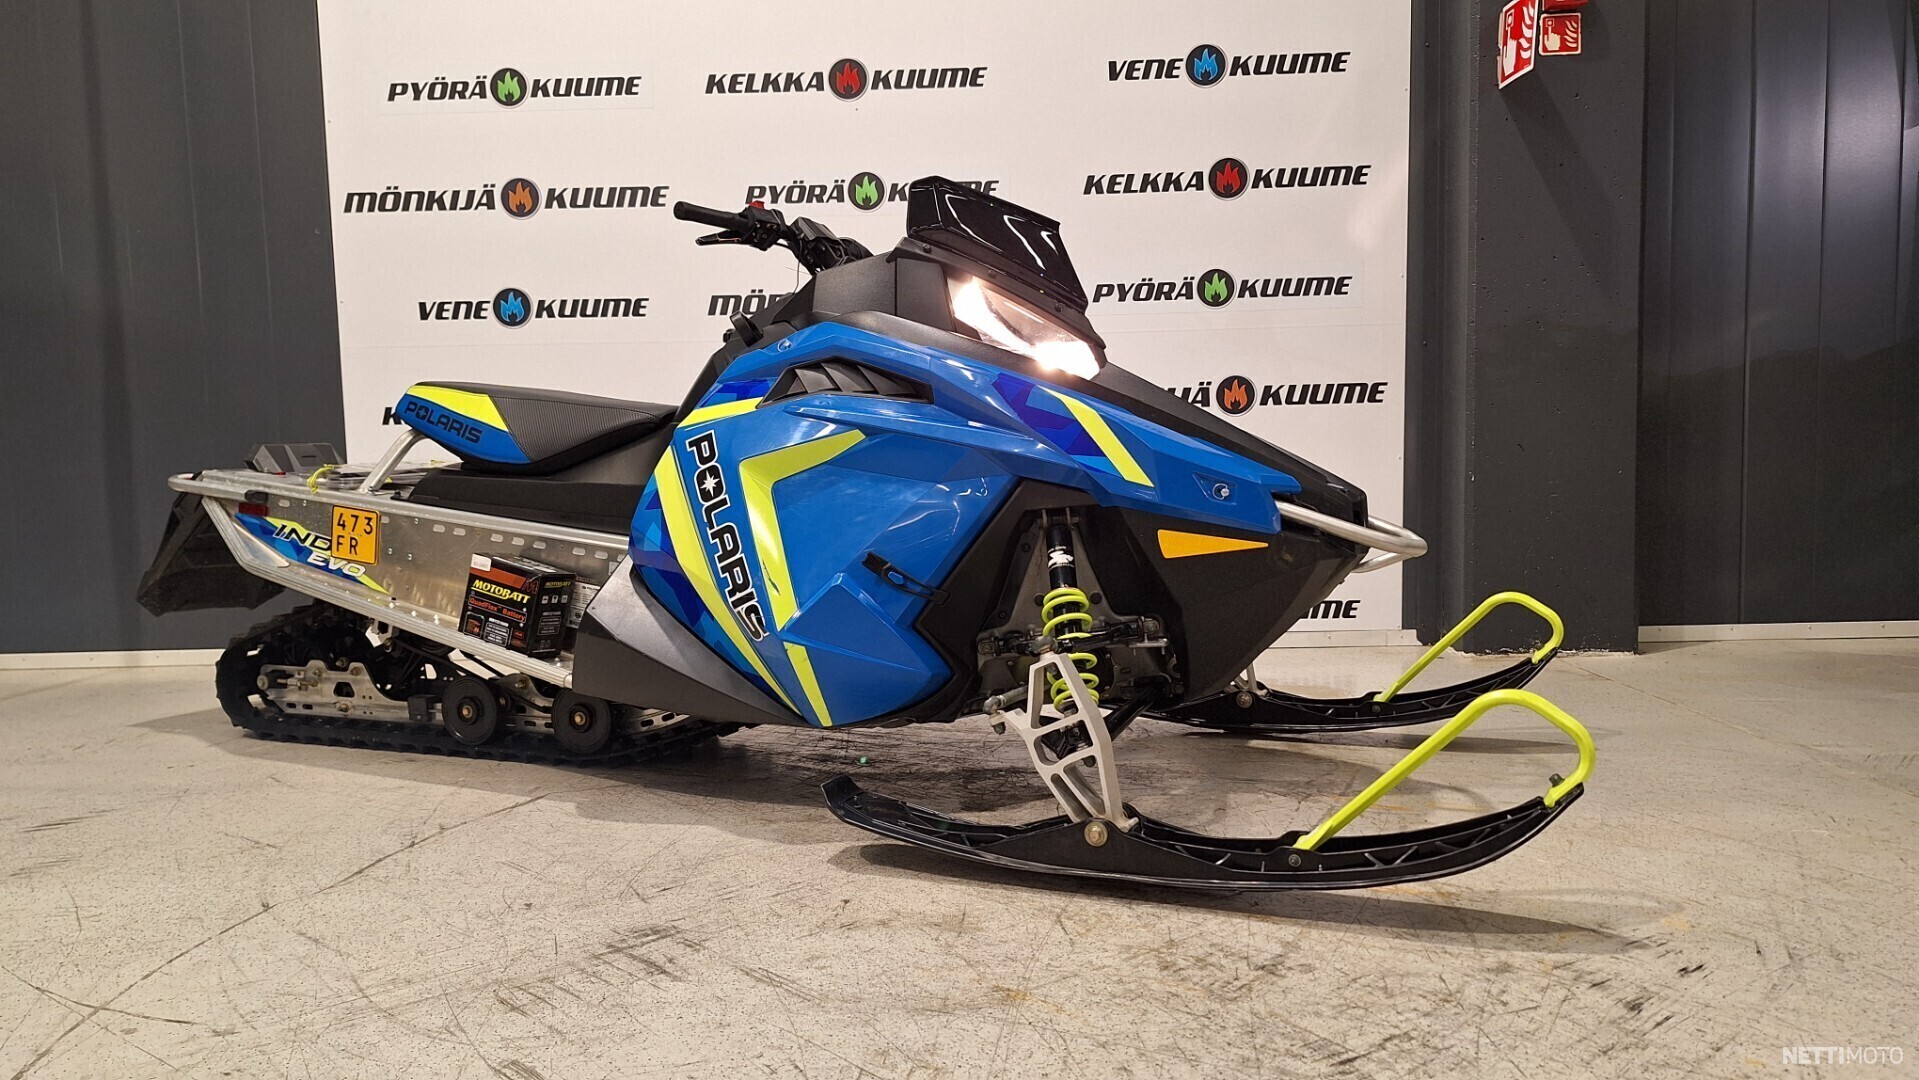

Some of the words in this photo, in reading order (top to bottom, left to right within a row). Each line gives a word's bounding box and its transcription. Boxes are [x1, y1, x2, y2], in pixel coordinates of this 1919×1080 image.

[1107, 58, 1181, 82] VENE
[1229, 52, 1351, 76] KUUME
[387, 76, 487, 102] PYÖRÄ
[530, 76, 642, 99] KUUME
[705, 72, 824, 95] KELKKA
[871, 67, 988, 90] KUUME
[745, 179, 845, 204] PYÖRÄ
[1083, 171, 1204, 195] KELKKA
[1251, 165, 1371, 189] KUUME
[344, 184, 496, 214] MÖNKIJÄ
[544, 186, 670, 209] KUUME
[1092, 277, 1195, 303] PYÖRÄ
[1237, 276, 1352, 298] KUUME
[418, 300, 491, 321] VENE
[534, 298, 649, 319] KUUME
[1259, 382, 1389, 406] KUUME
[404, 401, 483, 444] POLARIS
[337, 512, 374, 535] 473
[685, 429, 770, 642] POLARIS
[272, 523, 333, 552] IND
[336, 535, 358, 556] FR
[306, 550, 367, 578] EVO
[471, 579, 531, 604] MOTOBATT
